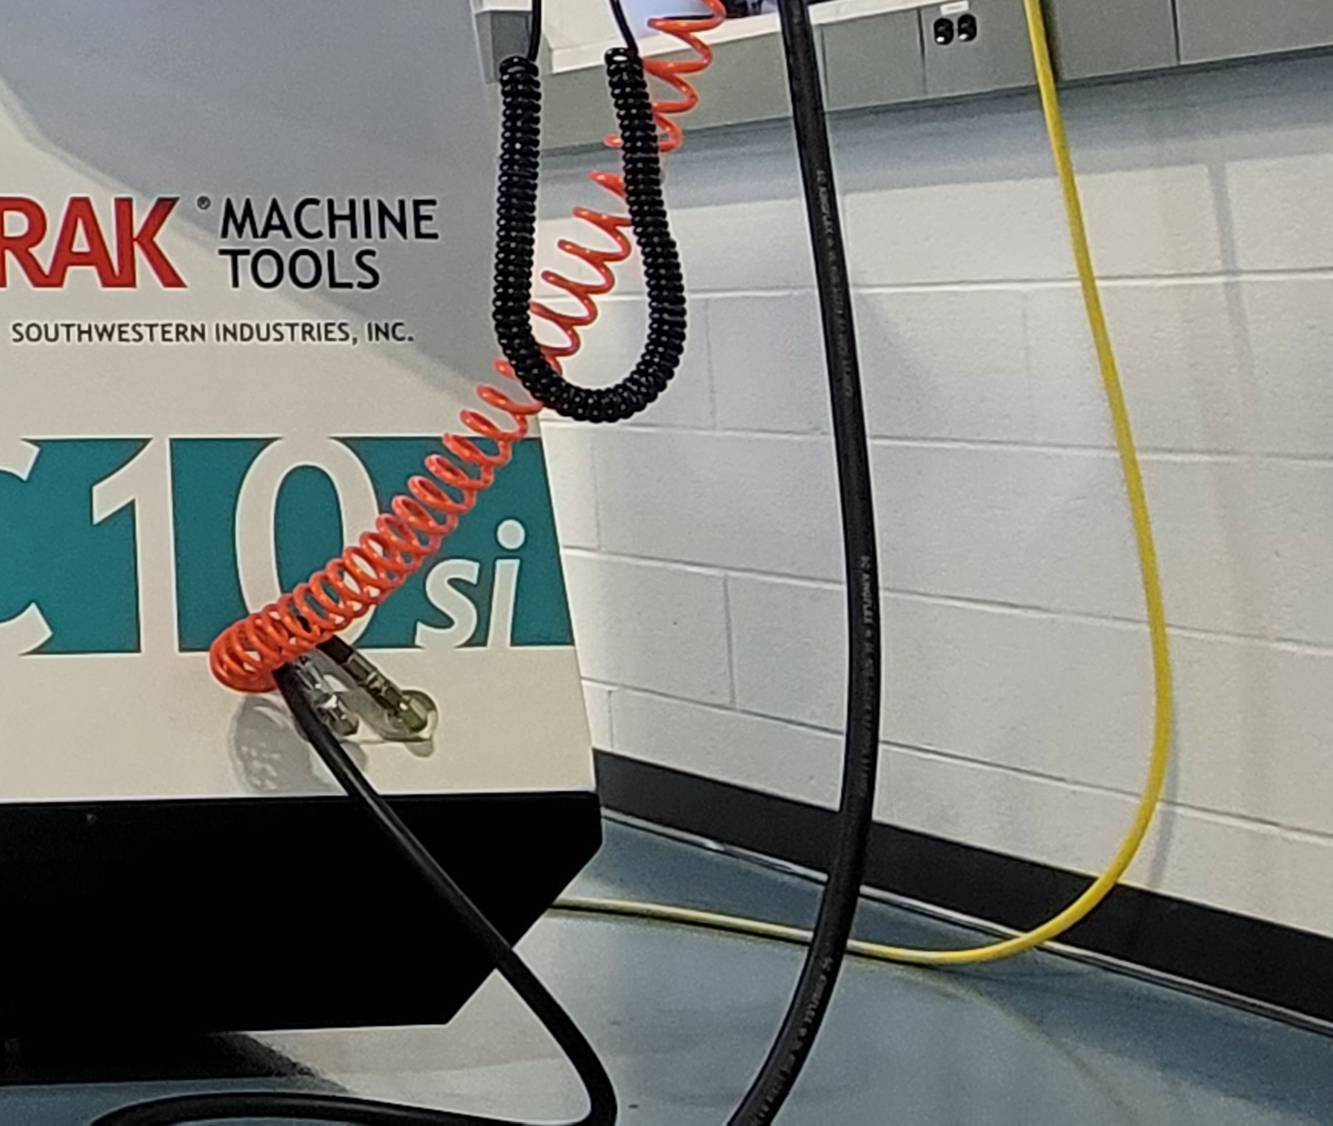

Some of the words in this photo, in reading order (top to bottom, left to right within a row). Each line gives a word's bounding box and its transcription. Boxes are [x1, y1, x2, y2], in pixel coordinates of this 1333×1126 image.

[220, 198, 440, 240] MACHINE
[218, 248, 381, 289] TOOLS
[11, 322, 207, 343] SOUTHWESTERN
[214, 321, 358, 346] INDUSTRIES,
[367, 321, 415, 342] INC.
